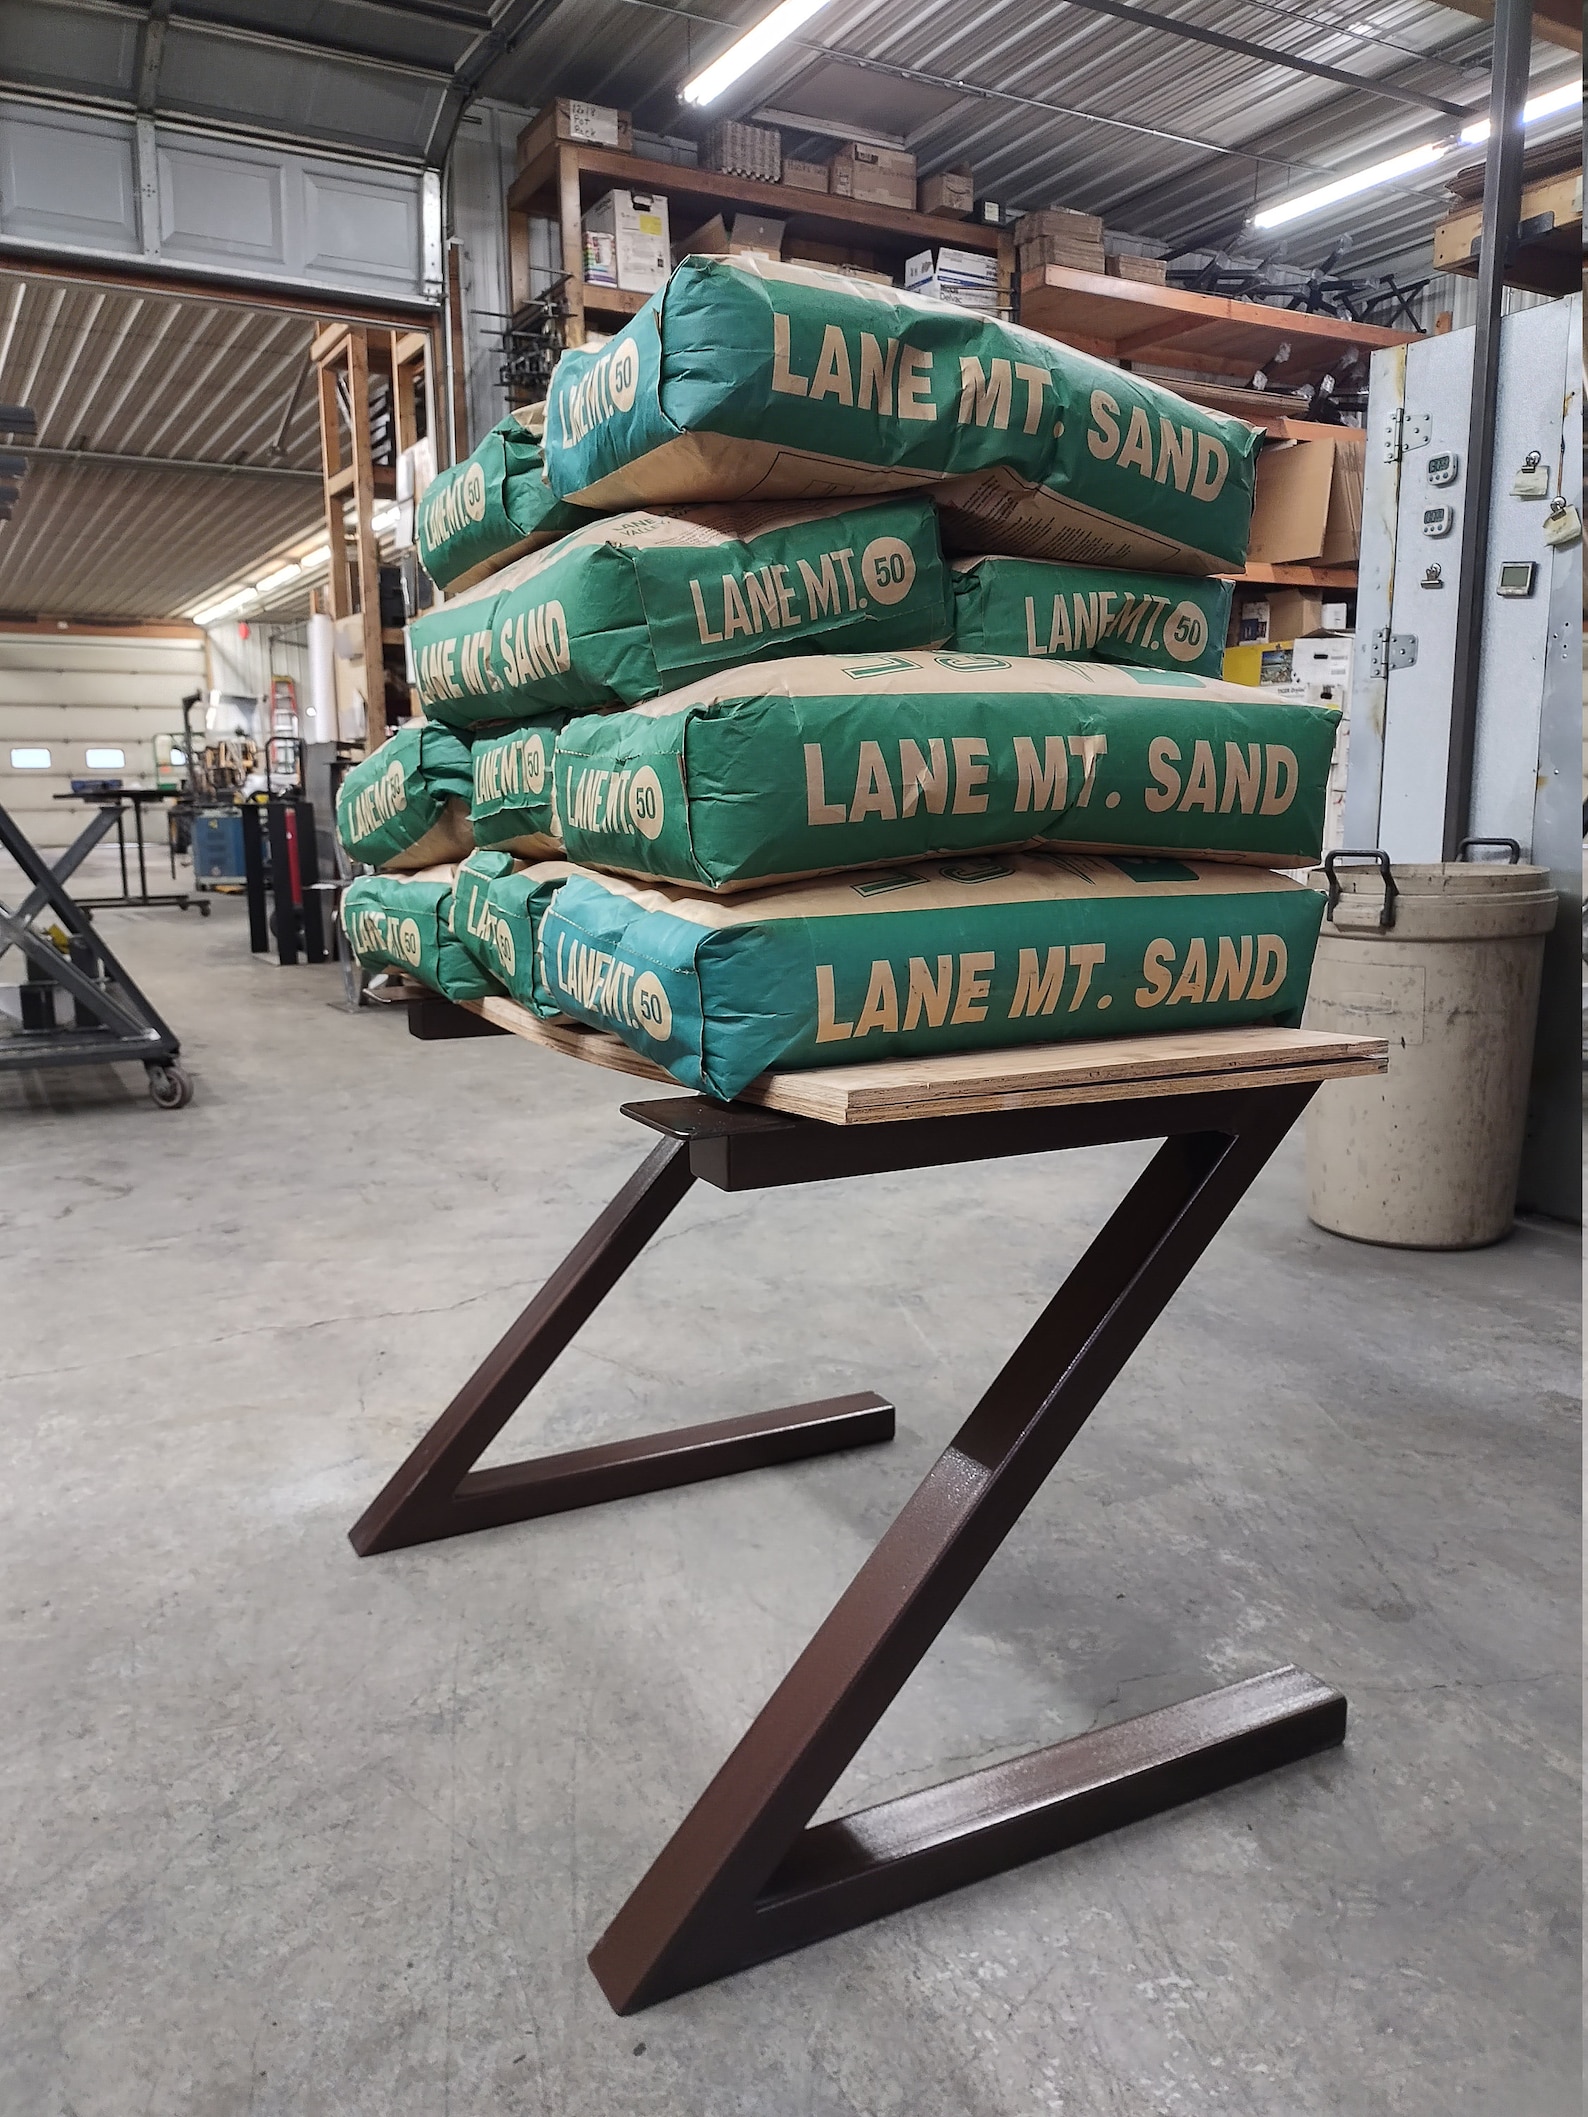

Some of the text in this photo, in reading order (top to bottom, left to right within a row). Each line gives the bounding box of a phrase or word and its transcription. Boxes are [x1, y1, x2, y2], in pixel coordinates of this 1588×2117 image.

[940, 292, 962, 304] Delvac
[615, 355, 632, 393] 50
[772, 312, 1230, 503] LANE MT. SAND
[425, 473, 481, 553] LANE MT. 50
[613, 517, 658, 532] LANE
[689, 548, 905, 645] LANE MT. 50
[1025, 591, 1201, 656] LANE MT. 50
[413, 637, 465, 707] LANE
[500, 599, 571, 689] SAND
[347, 784, 384, 845] LANE
[389, 772, 401, 799] 50
[475, 746, 504, 806] LANE
[527, 750, 540, 778] 50
[566, 765, 656, 835] LANE MT. 50
[804, 734, 1300, 827] LANE MT. SAND
[404, 931, 417, 954] 50
[500, 934, 512, 962] 50
[557, 930, 663, 1030] LANE MT. 50
[815, 933, 1289, 1044] LANE MT. SAND
